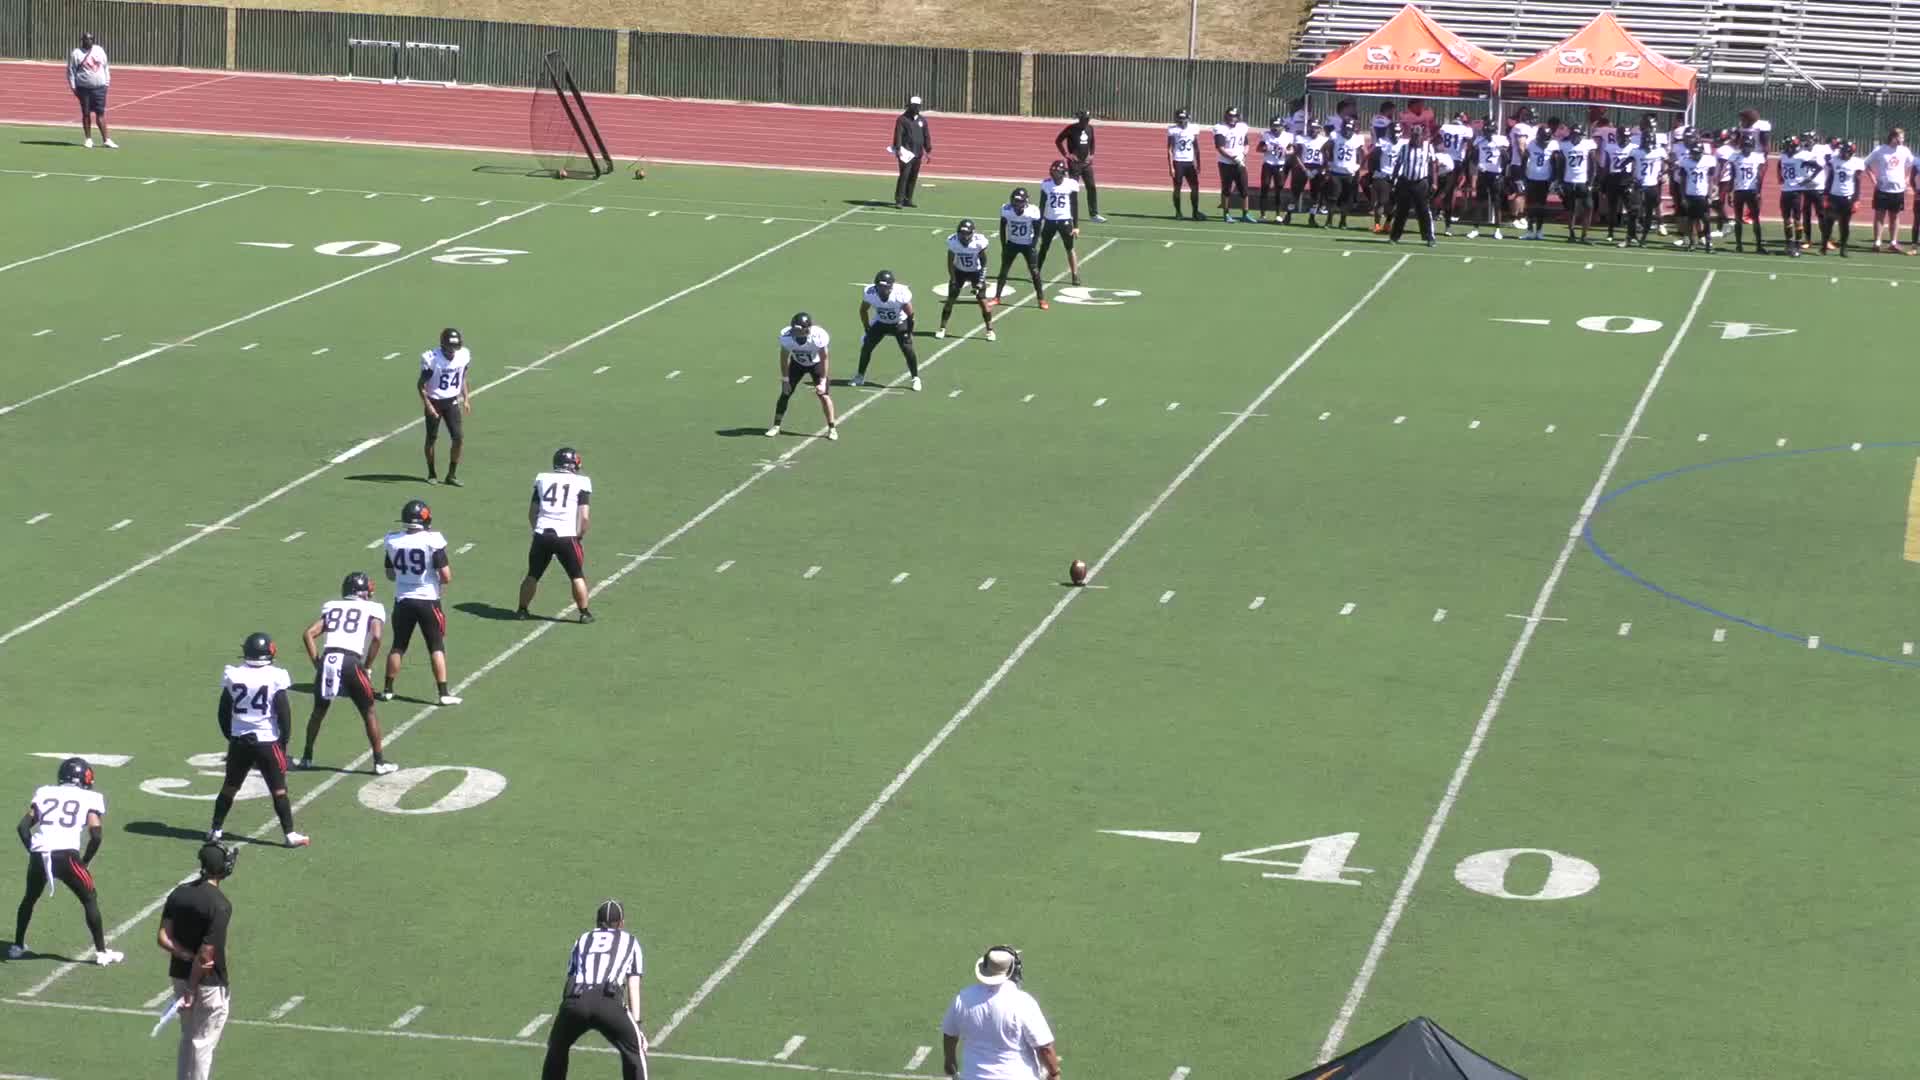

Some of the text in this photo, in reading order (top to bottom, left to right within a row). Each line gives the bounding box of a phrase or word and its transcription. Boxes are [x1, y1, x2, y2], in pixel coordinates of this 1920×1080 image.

[1049, 195, 1066, 208] 26
[1011, 225, 1028, 237] 20
[960, 256, 974, 268] 15
[439, 372, 460, 390] 64
[543, 483, 571, 508] 41
[394, 548, 426, 575] 49
[324, 608, 362, 634] 88
[232, 683, 269, 714] 24
[40, 798, 81, 828] 29
[588, 931, 614, 953] B
